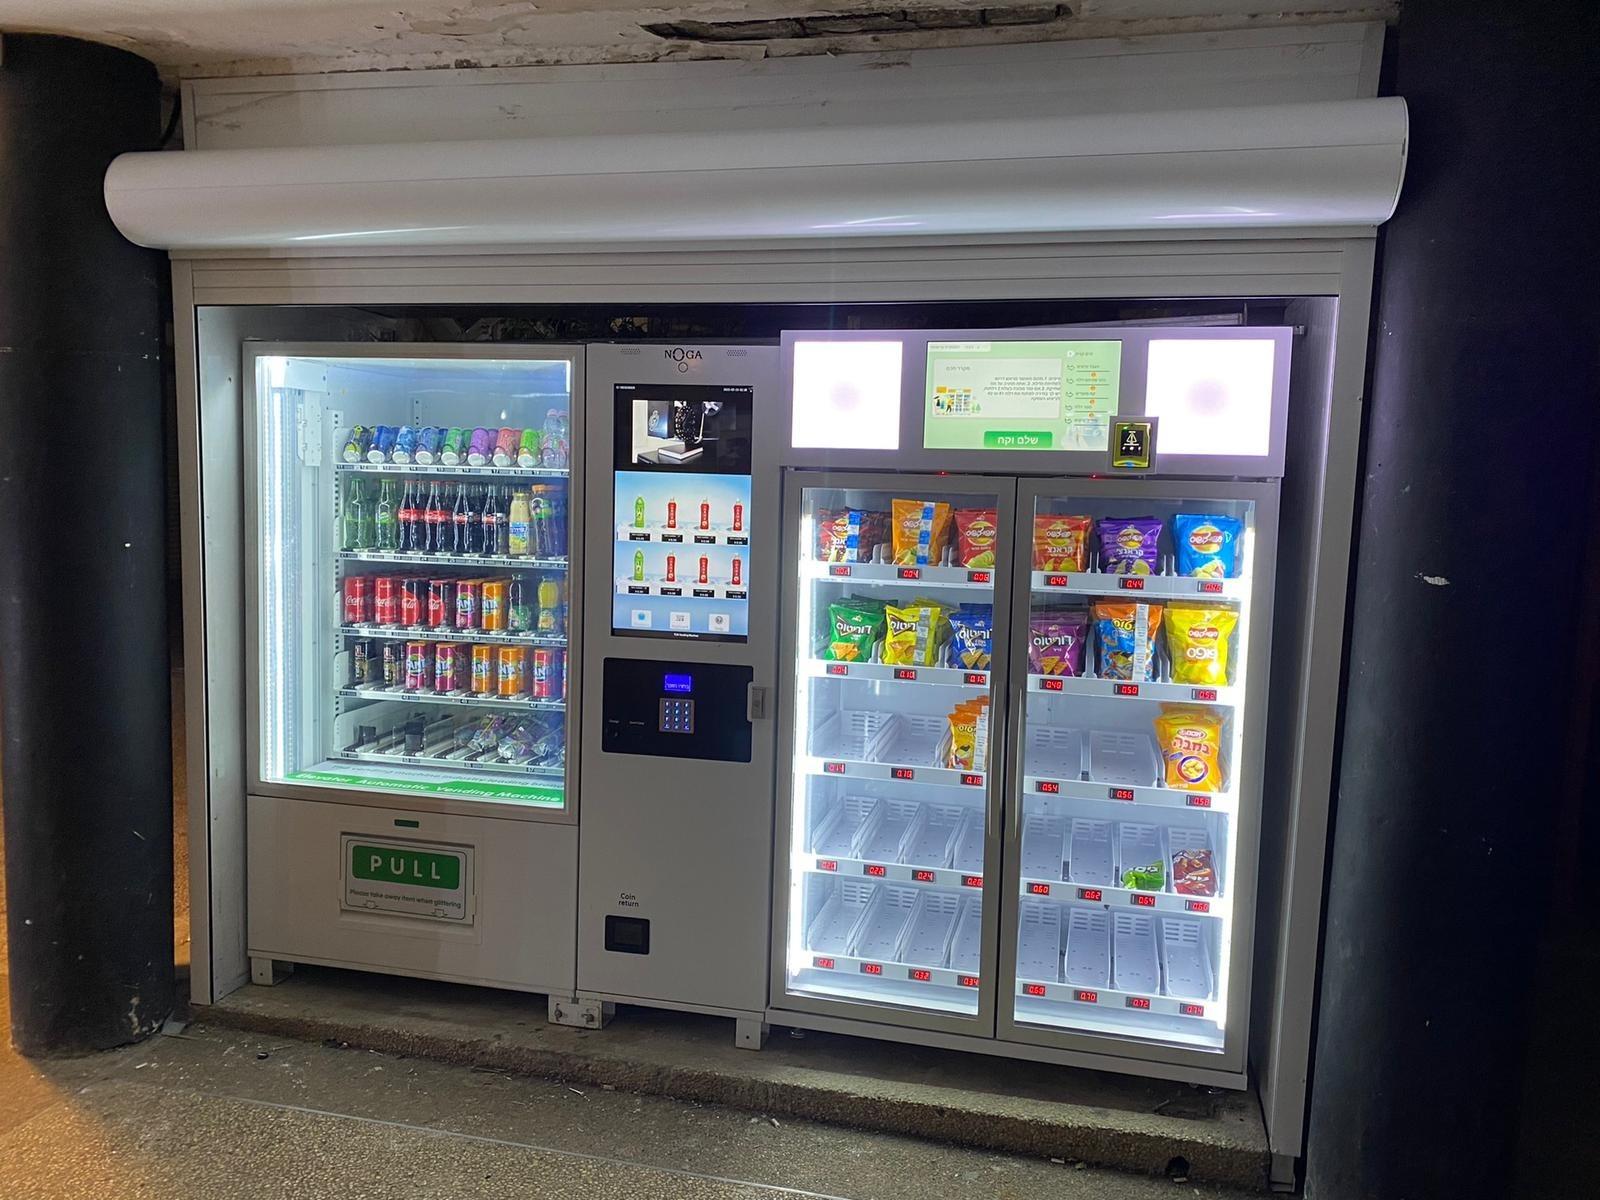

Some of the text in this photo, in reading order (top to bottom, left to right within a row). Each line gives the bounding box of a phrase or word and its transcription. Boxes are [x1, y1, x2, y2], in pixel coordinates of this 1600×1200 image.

[664, 347, 703, 362] NOGA
[997, 434, 1039, 446] שלם וקח
[836, 622, 872, 635] דוריטוס
[1033, 635, 1072, 646] דוריטוס
[1172, 736, 1210, 754] במבה
[356, 778, 430, 791] Automatic
[435, 785, 495, 797] Vending
[496, 791, 561, 802] Machine
[370, 854, 441, 880] PULL
[620, 892, 636, 901] Coin
[618, 900, 639, 908] return
